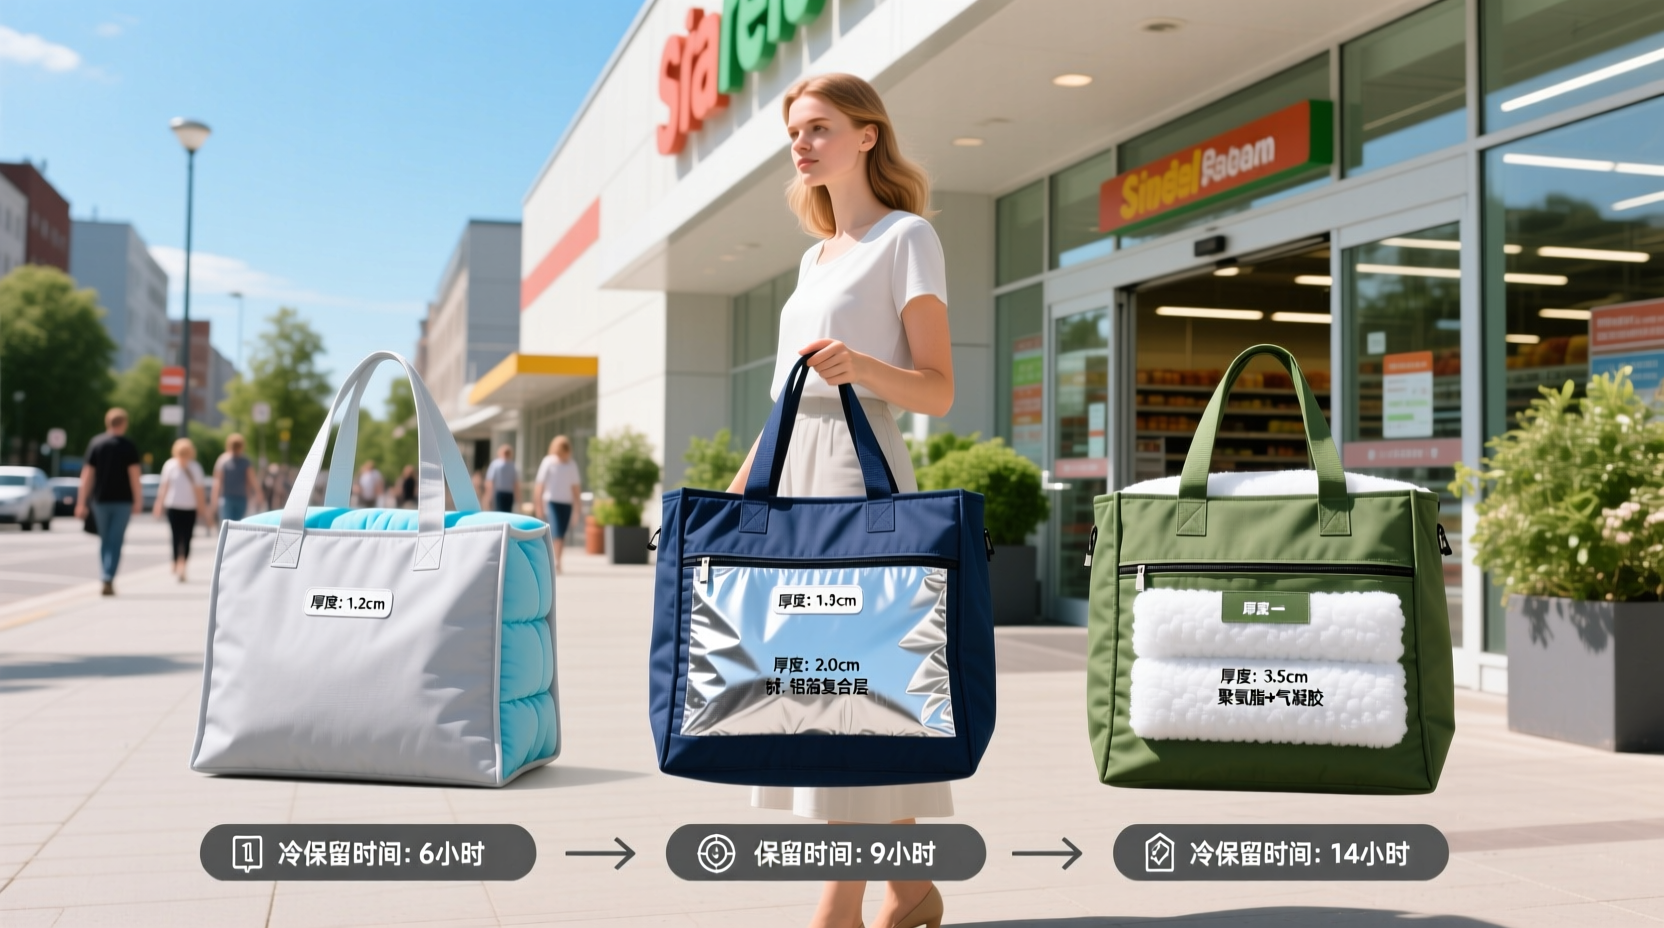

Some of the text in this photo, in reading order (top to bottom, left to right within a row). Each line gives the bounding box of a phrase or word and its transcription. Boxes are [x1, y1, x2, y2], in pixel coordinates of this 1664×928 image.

[347, 597, 385, 610] 1.2cm
[815, 657, 860, 672] 2.0cm
[1264, 669, 1308, 684] 3.5cm
